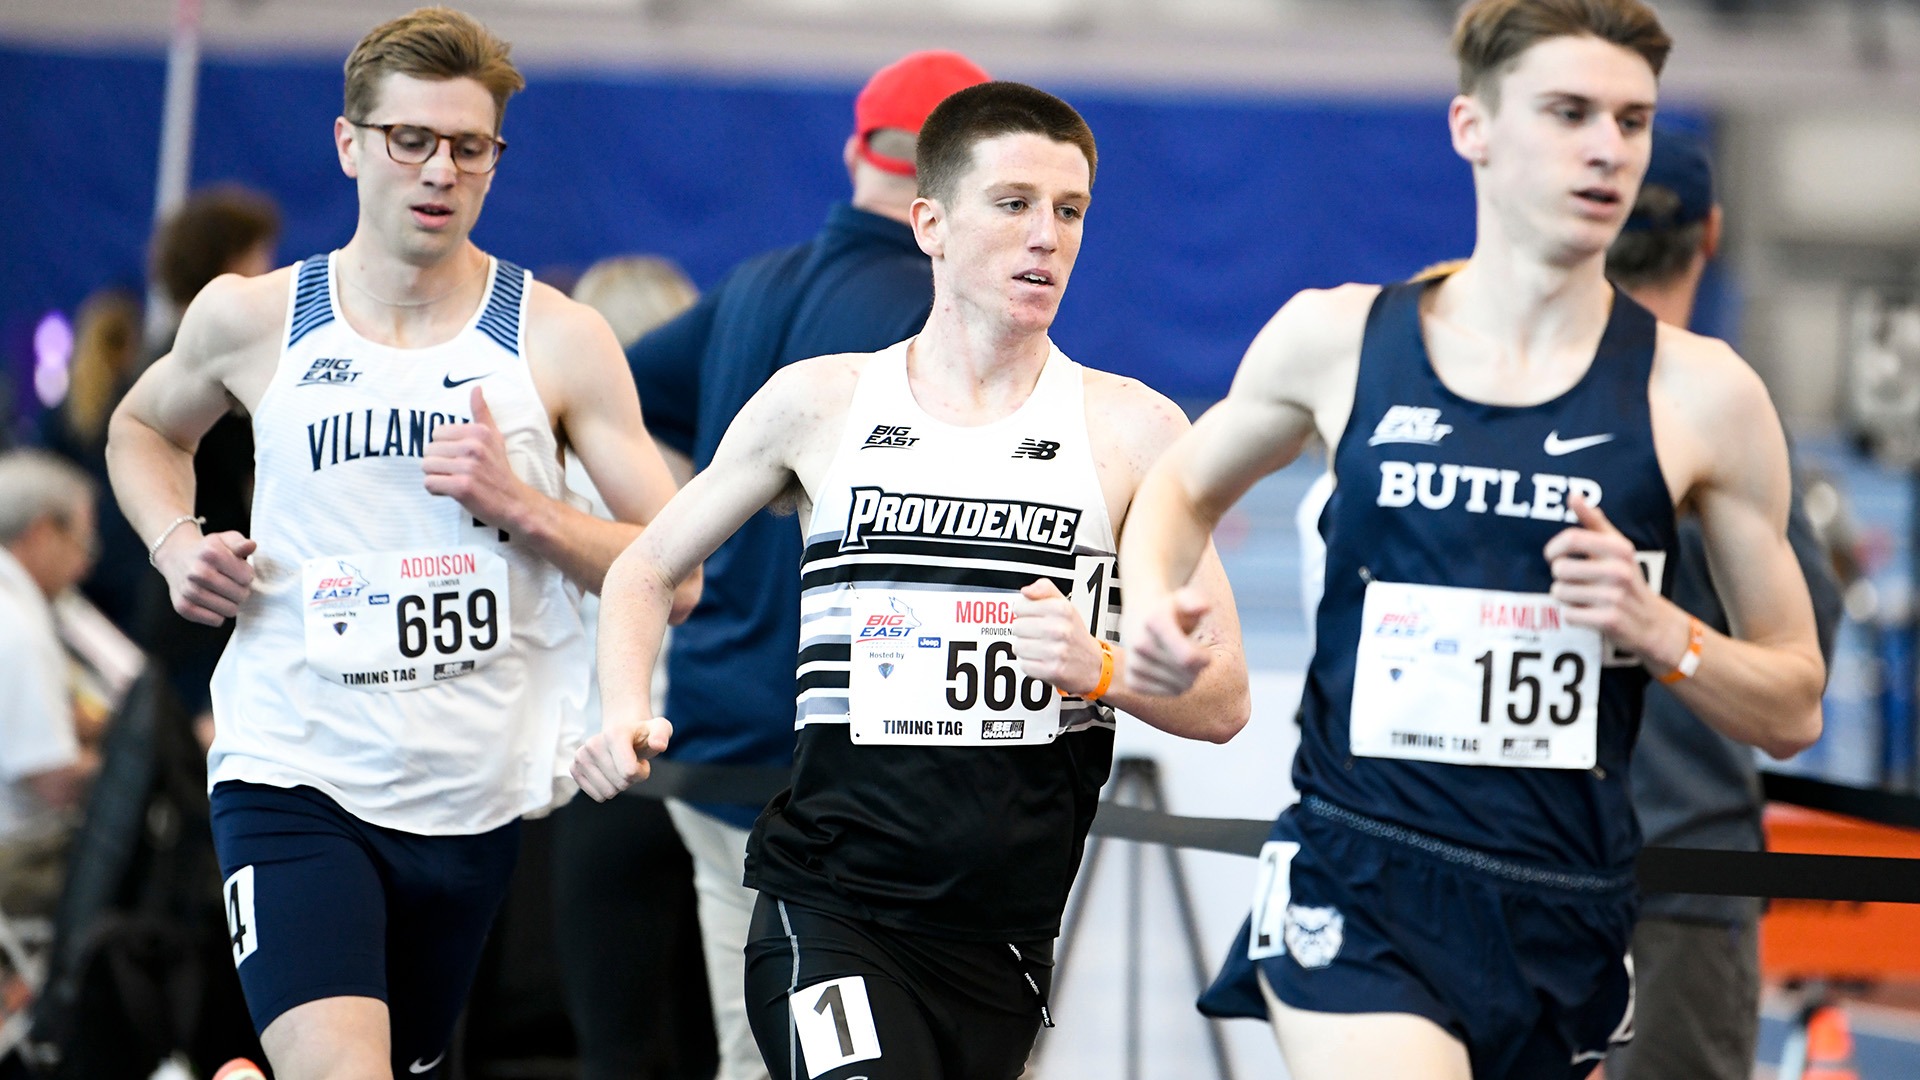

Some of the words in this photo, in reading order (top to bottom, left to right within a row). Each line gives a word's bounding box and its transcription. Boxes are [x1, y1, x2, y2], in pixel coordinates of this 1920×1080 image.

[310, 358, 353, 370] BIG
[301, 371, 363, 383] EAST
[871, 424, 912, 436] BIG
[864, 435, 921, 447] EAST
[1376, 460, 1603, 524] BUTLER
[842, 487, 1081, 550] PROVIDENCE
[400, 553, 477, 579] ADDISON
[318, 576, 354, 589] BIG
[312, 587, 362, 600] EAST
[396, 588, 499, 660] 659
[866, 614, 906, 626] BIG
[860, 627, 916, 638] EAST
[980, 627, 1015, 636] PROVIDEN
[919, 638, 940, 648] Jeep
[869, 651, 894, 659] Hosted
[896, 651, 905, 660] by
[342, 670, 389, 686] TIMING
[394, 667, 417, 683] TAG
[1474, 650, 1586, 726] 153
[883, 719, 933, 735] TIMING
[937, 720, 963, 736] TAG
[229, 880, 247, 956] 4
[813, 984, 855, 1058] 1
